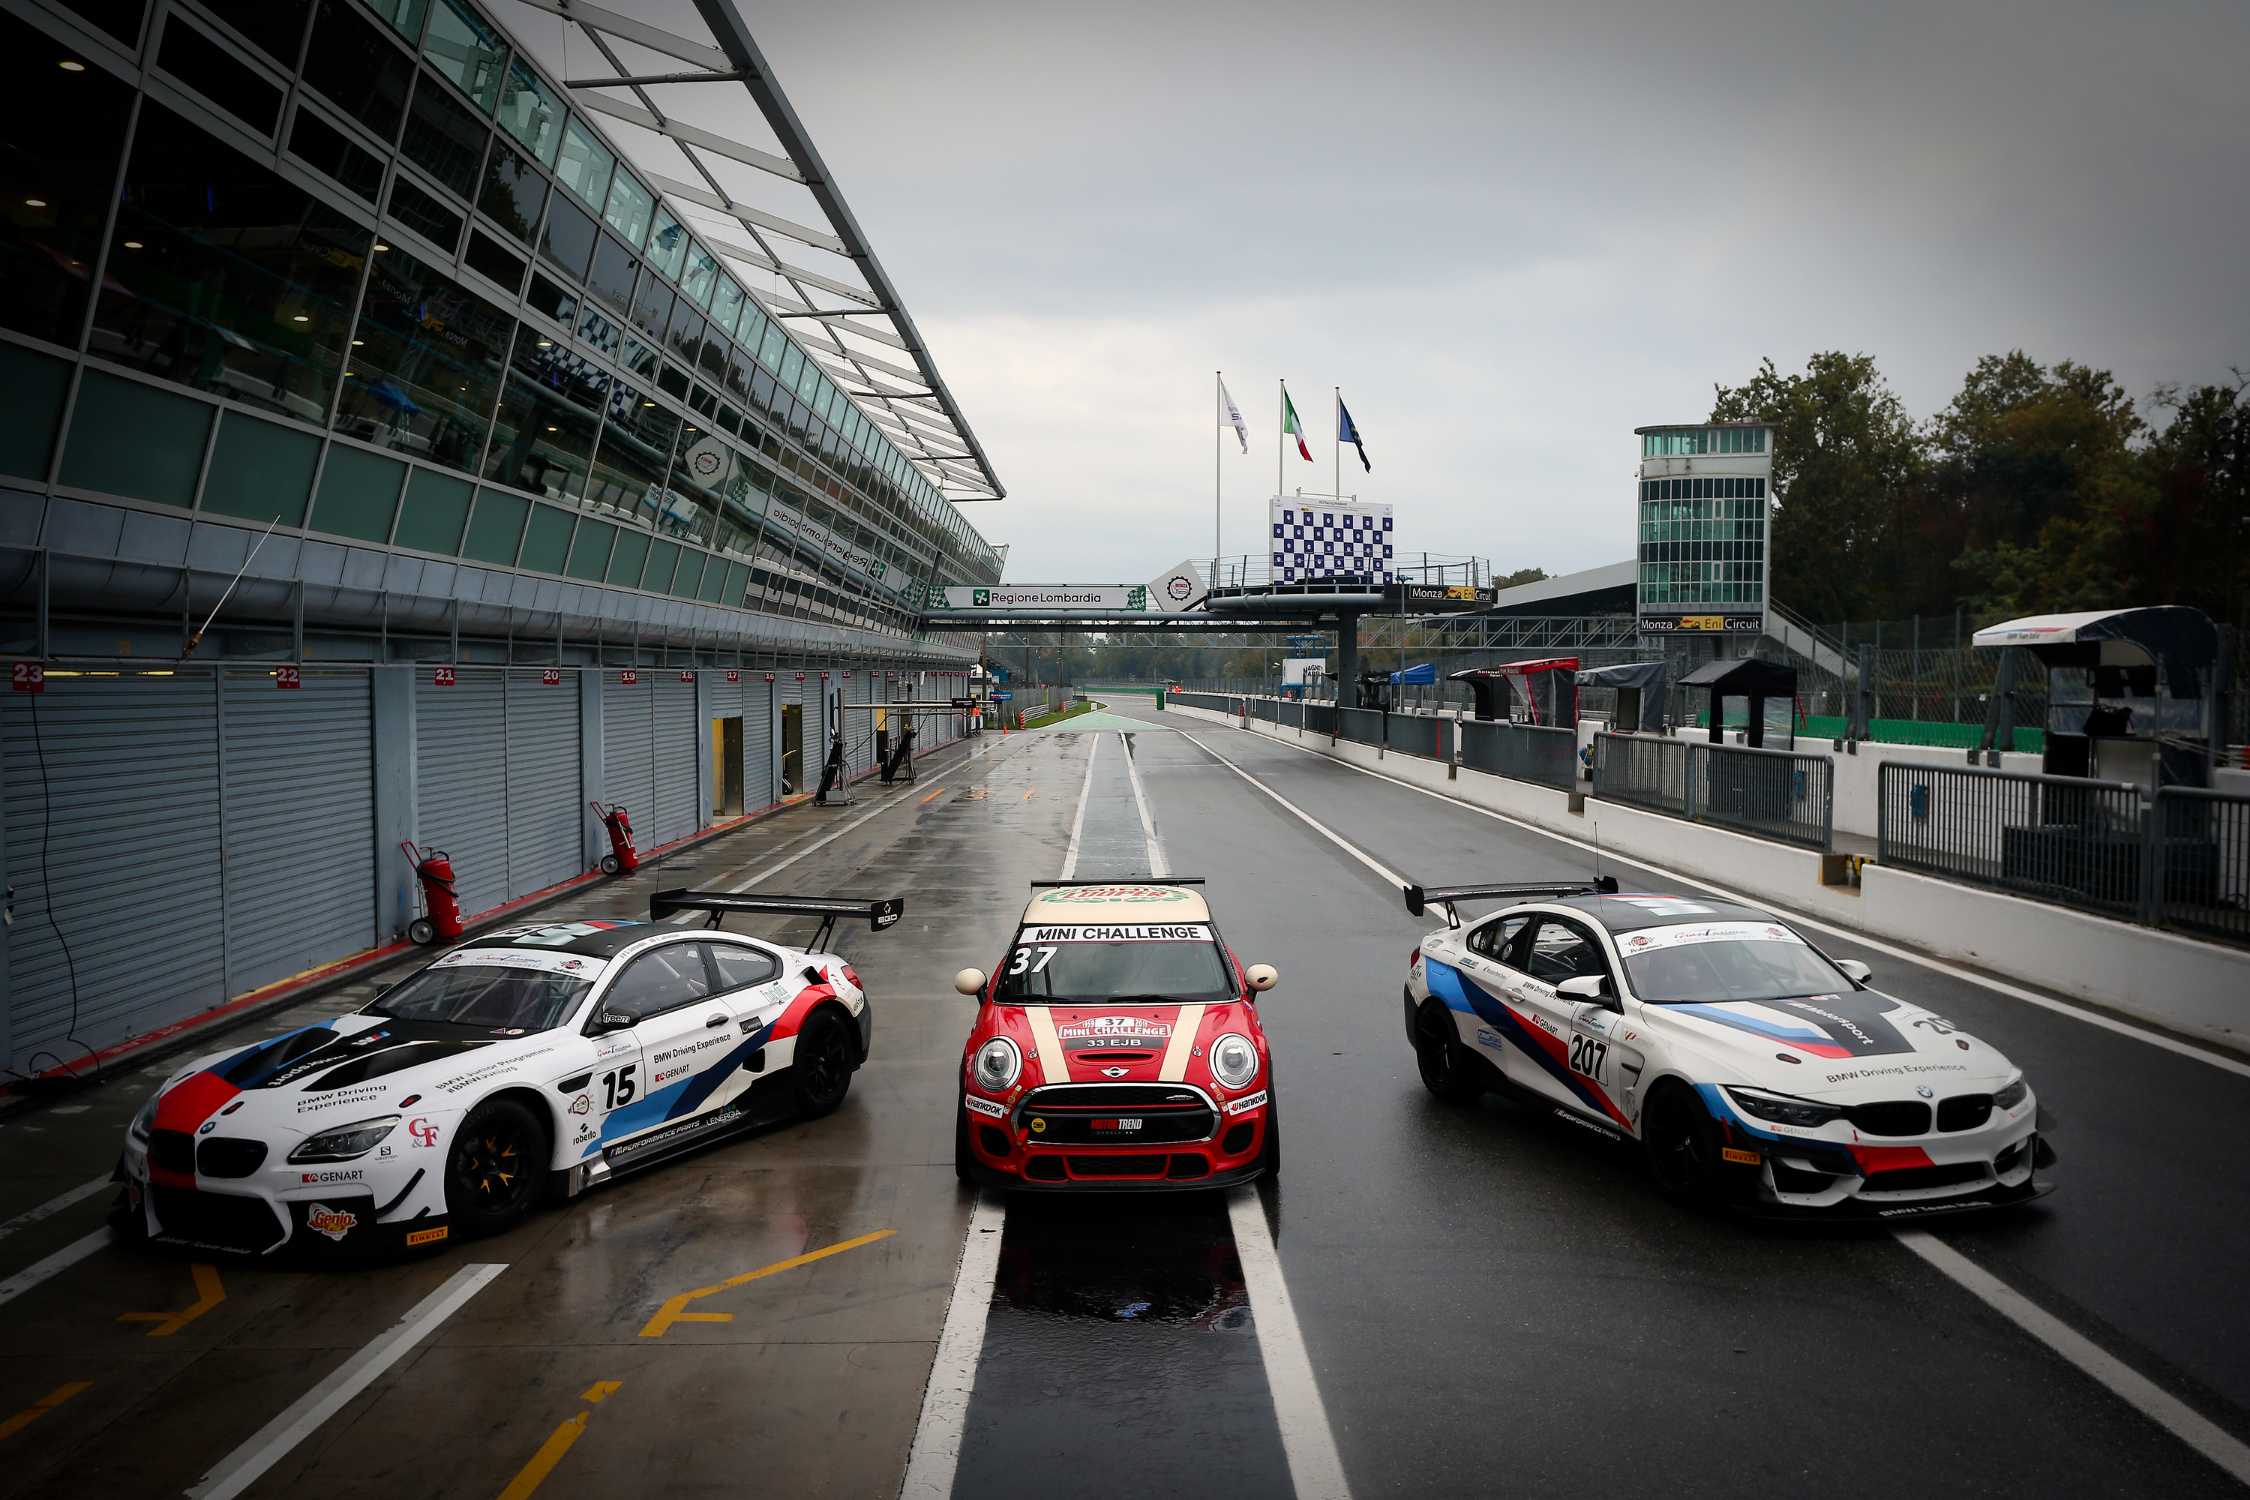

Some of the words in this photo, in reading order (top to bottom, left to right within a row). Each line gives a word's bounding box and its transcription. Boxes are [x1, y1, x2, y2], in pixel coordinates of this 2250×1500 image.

[991, 592, 1039, 605] Regione
[1040, 592, 1101, 603] Lombardia
[1412, 588, 1442, 598] Monza
[1641, 619, 1673, 630] Monza
[1705, 619, 1722, 630] Eni
[1725, 618, 1759, 629] Circuit
[13, 664, 43, 682] 23
[277, 668, 299, 682] 22
[436, 669, 454, 681] 21
[543, 670, 559, 681] 20
[622, 672, 636, 681] 19
[1035, 928, 1076, 941] MINI
[1082, 927, 1201, 940] CHALLENGE
[1009, 946, 1058, 975] 37
[1105, 1018, 1125, 1026] 37
[1063, 1028, 1089, 1037] MINI
[1094, 1026, 1167, 1036] CHALLENGE
[653, 1050, 672, 1064] BMW
[672, 1044, 697, 1058] Driving
[696, 1033, 731, 1051] Experience
[1087, 1039, 1105, 1047] 33
[1110, 1039, 1142, 1047] EJB
[1570, 1034, 1608, 1081] 207
[665, 1064, 690, 1079] GENART
[1826, 1071, 1859, 1084] BMW
[1860, 1066, 1904, 1079] Driving
[1904, 1064, 1967, 1074] Experience
[435, 1076, 465, 1090] BMW
[602, 1063, 636, 1110] 15
[297, 1093, 334, 1106] BMW
[338, 1084, 387, 1097] Driving
[297, 1095, 377, 1113] Experience
[622, 1128, 676, 1153] PERFORMANCE
[676, 1120, 700, 1134] PARTS
[320, 1170, 364, 1183] GENART
[410, 1230, 446, 1244] PIRELLI
